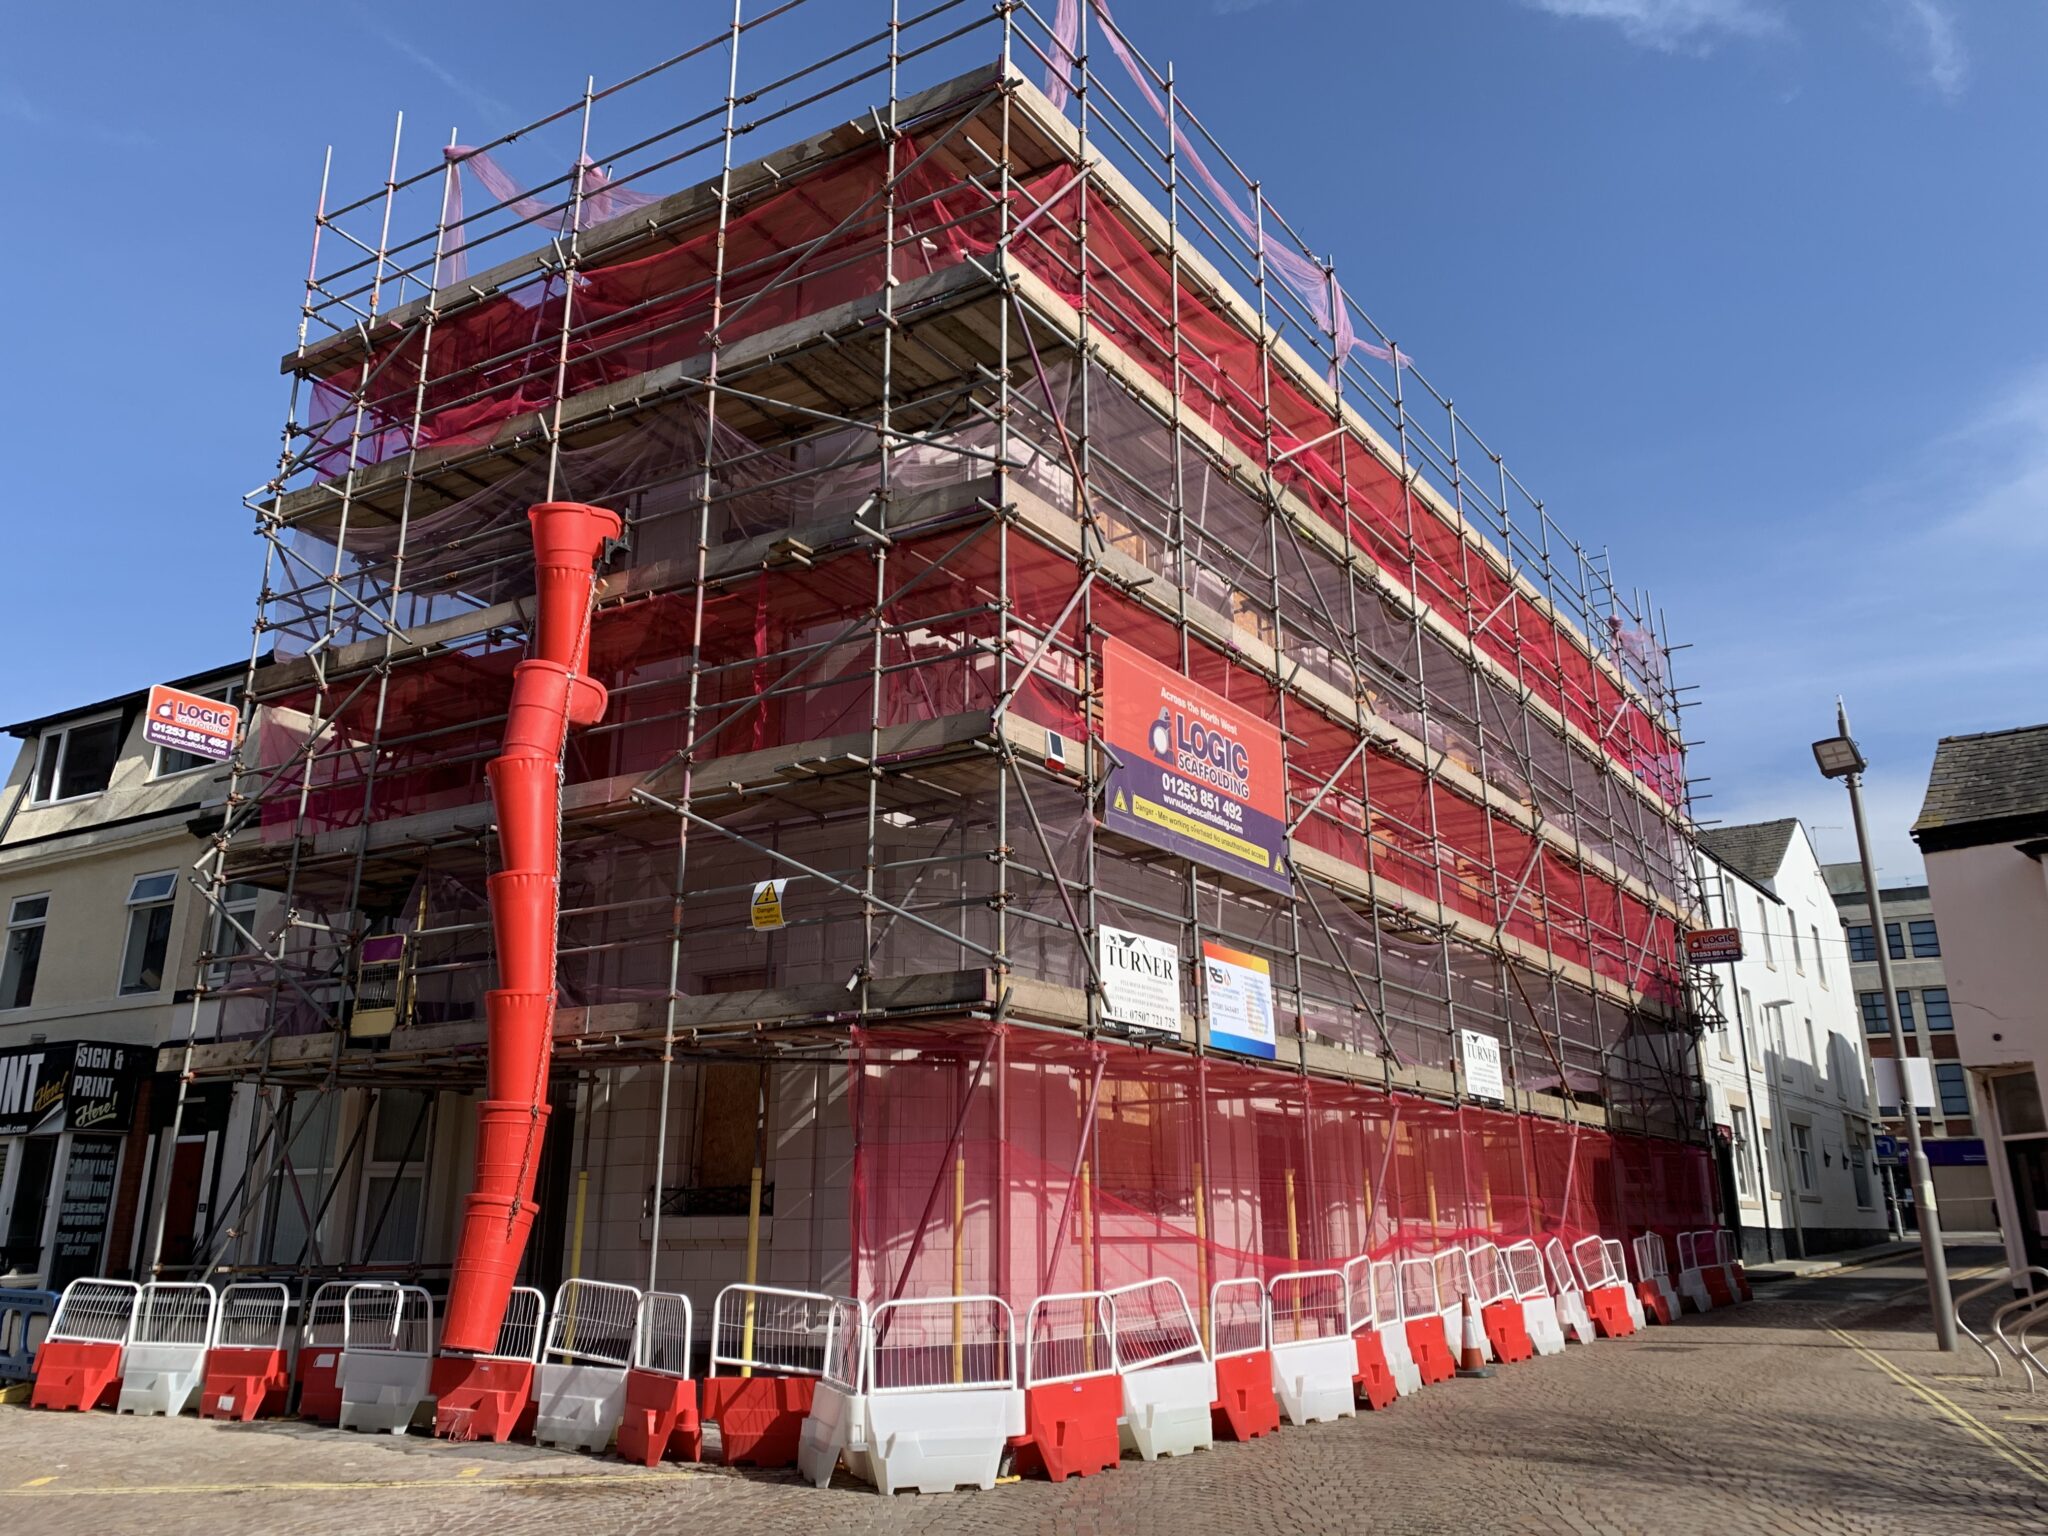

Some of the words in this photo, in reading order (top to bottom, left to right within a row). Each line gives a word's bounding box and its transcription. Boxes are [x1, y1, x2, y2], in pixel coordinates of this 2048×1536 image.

[177, 702, 230, 728] LOGIC
[1161, 687, 1186, 708] Across
[1187, 700, 1199, 715] the
[1200, 707, 1220, 723] North
[1220, 718, 1238, 736] West
[152, 722, 185, 738] 01253
[187, 731, 206, 743] 851
[208, 737, 228, 749] 492
[177, 716, 229, 735] SCAFFOLDING
[151, 732, 226, 756] www.logicscaffolding.com
[1177, 713, 1249, 780] LOGIC
[1178, 753, 1249, 799] SCAFFOLDING
[1162, 773, 1198, 803] 01253
[1200, 790, 1219, 812] 851
[1223, 801, 1243, 822] 492
[1135, 801, 1154, 816] Danger
[1158, 812, 1168, 822] Men
[1169, 817, 1190, 832] working
[1190, 824, 1213, 840] overhead
[1163, 795, 1243, 834] www.logicscaffolding.com
[1702, 934, 1736, 944] LOGIC
[1106, 944, 1174, 981] TURNER
[1110, 1006, 1127, 1018] EL:
[77, 1047, 111, 1069] SIGN
[114, 1050, 124, 1070] &
[1466, 1043, 1498, 1064] TURNER
[72, 1075, 114, 1098] PRINT
[75, 1091, 118, 1127] Here!
[67, 1158, 115, 1175] COPYING
[61, 1203, 107, 1214] DESIGN
